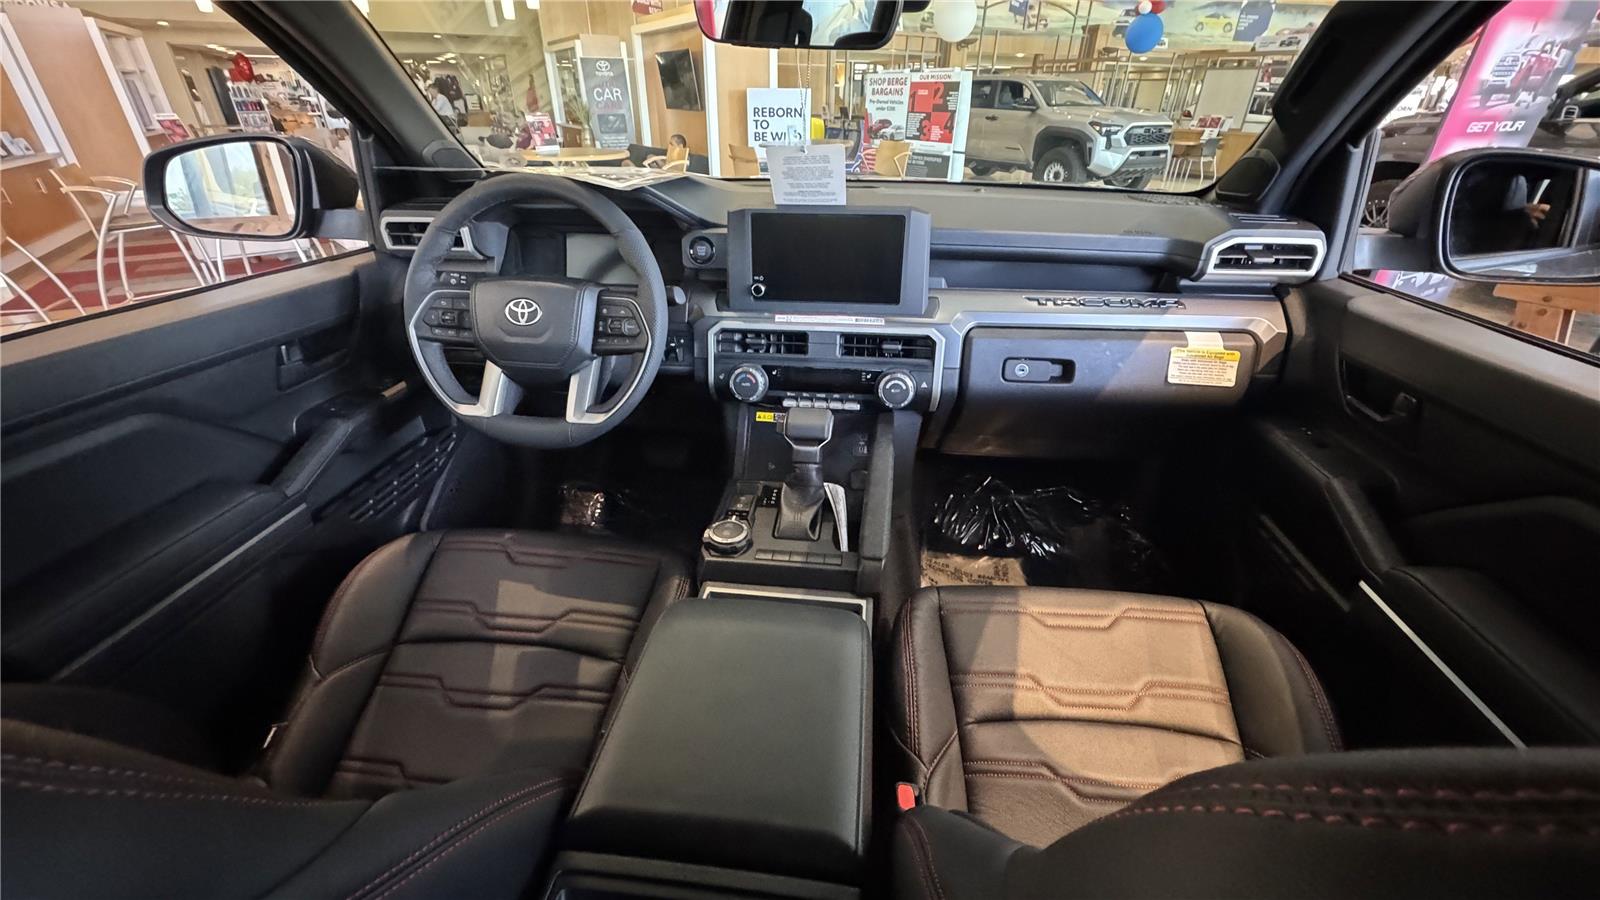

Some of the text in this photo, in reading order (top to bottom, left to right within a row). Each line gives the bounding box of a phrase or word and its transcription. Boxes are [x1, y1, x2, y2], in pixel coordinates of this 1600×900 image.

[869, 77, 908, 86] SHOP BERGE
[593, 88, 622, 101] CAR
[871, 87, 904, 96] BARGAINS
[932, 83, 944, 104] 2
[753, 107, 803, 118] REBORN
[753, 119, 770, 130] TO
[1466, 120, 1526, 133] GET YOUR
[754, 131, 768, 142] BE
[1022, 295, 1187, 310] TACOMA
